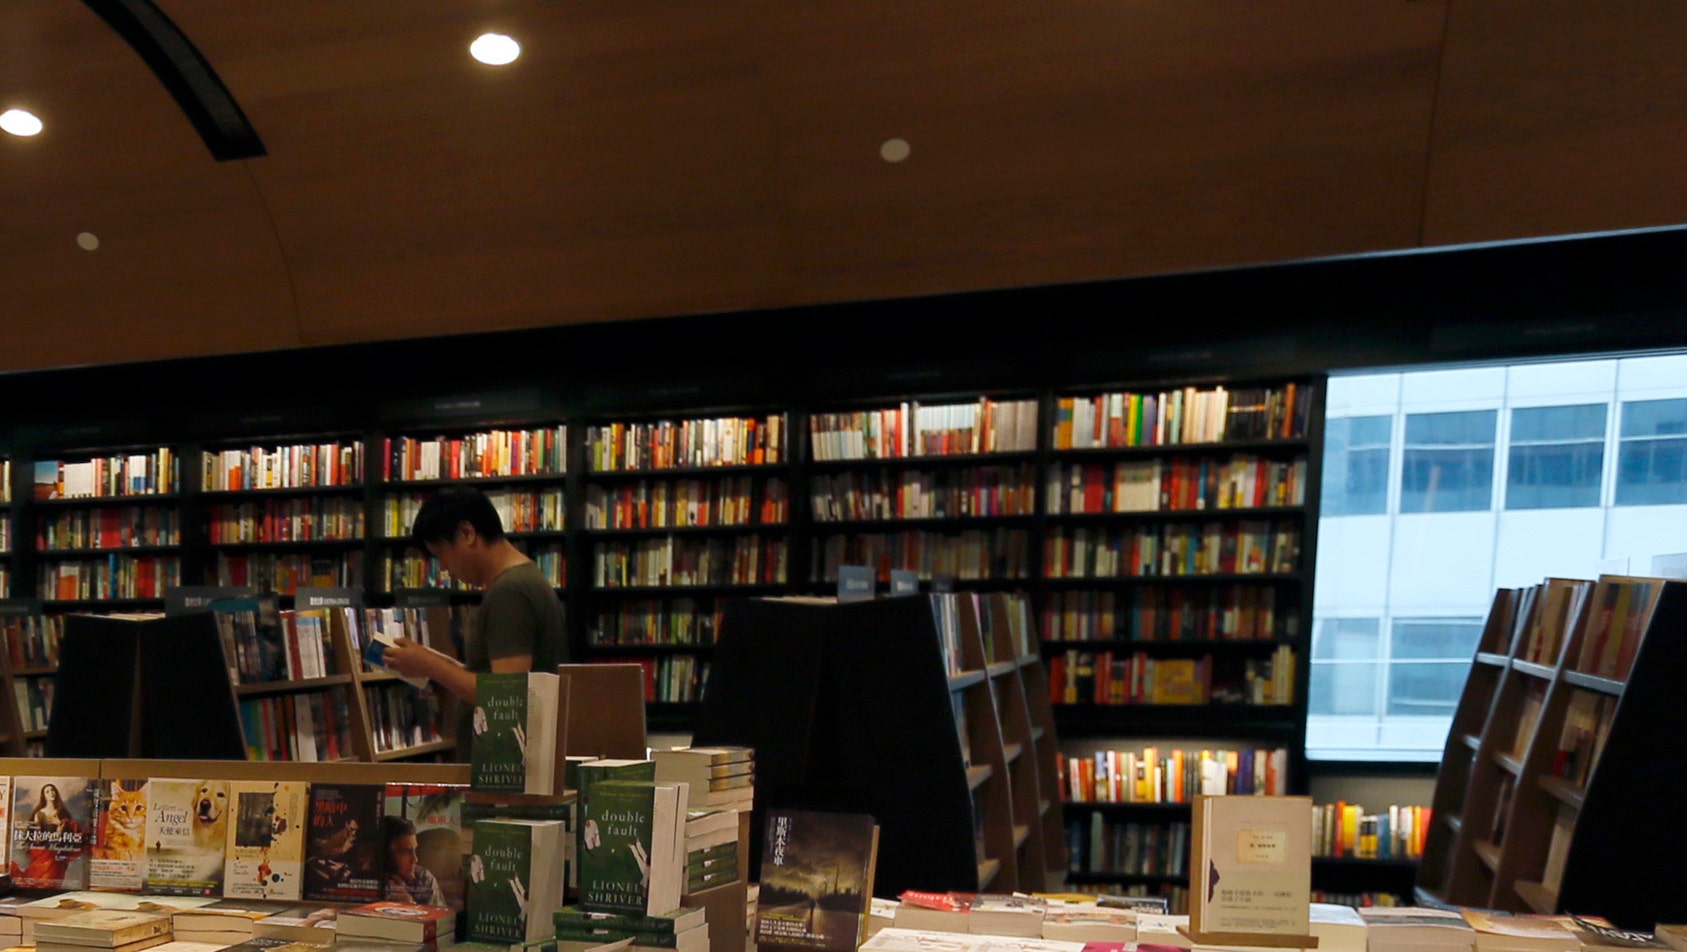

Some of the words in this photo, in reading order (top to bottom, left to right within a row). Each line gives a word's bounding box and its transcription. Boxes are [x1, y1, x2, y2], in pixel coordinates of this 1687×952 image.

[487, 696, 523, 708] double
[493, 709, 519, 721] fault
[155, 810, 188, 825] Angel
[600, 810, 645, 824] double
[607, 823, 638, 837] fault
[484, 845, 523, 860] double
[490, 859, 517, 872] fault
[592, 880, 641, 892] LIONEL
[587, 892, 643, 906] SHRIVER
